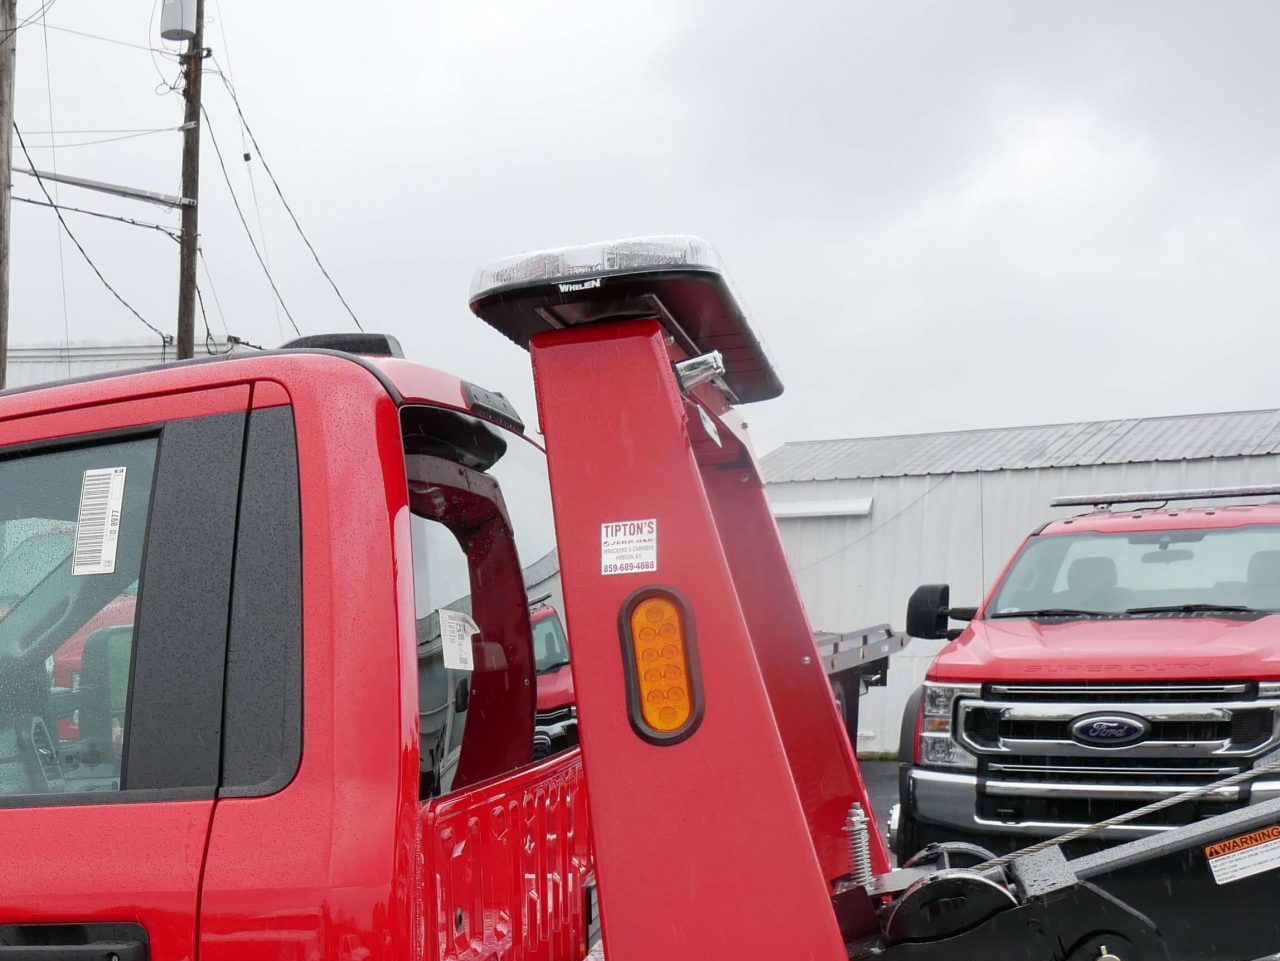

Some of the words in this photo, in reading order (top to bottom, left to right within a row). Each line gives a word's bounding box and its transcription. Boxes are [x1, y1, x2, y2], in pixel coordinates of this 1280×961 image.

[558, 278, 601, 292] WHELEN
[603, 521, 654, 538] TIPTON'S
[1088, 721, 1129, 738] Ford
[1219, 827, 1280, 853] WARNING
